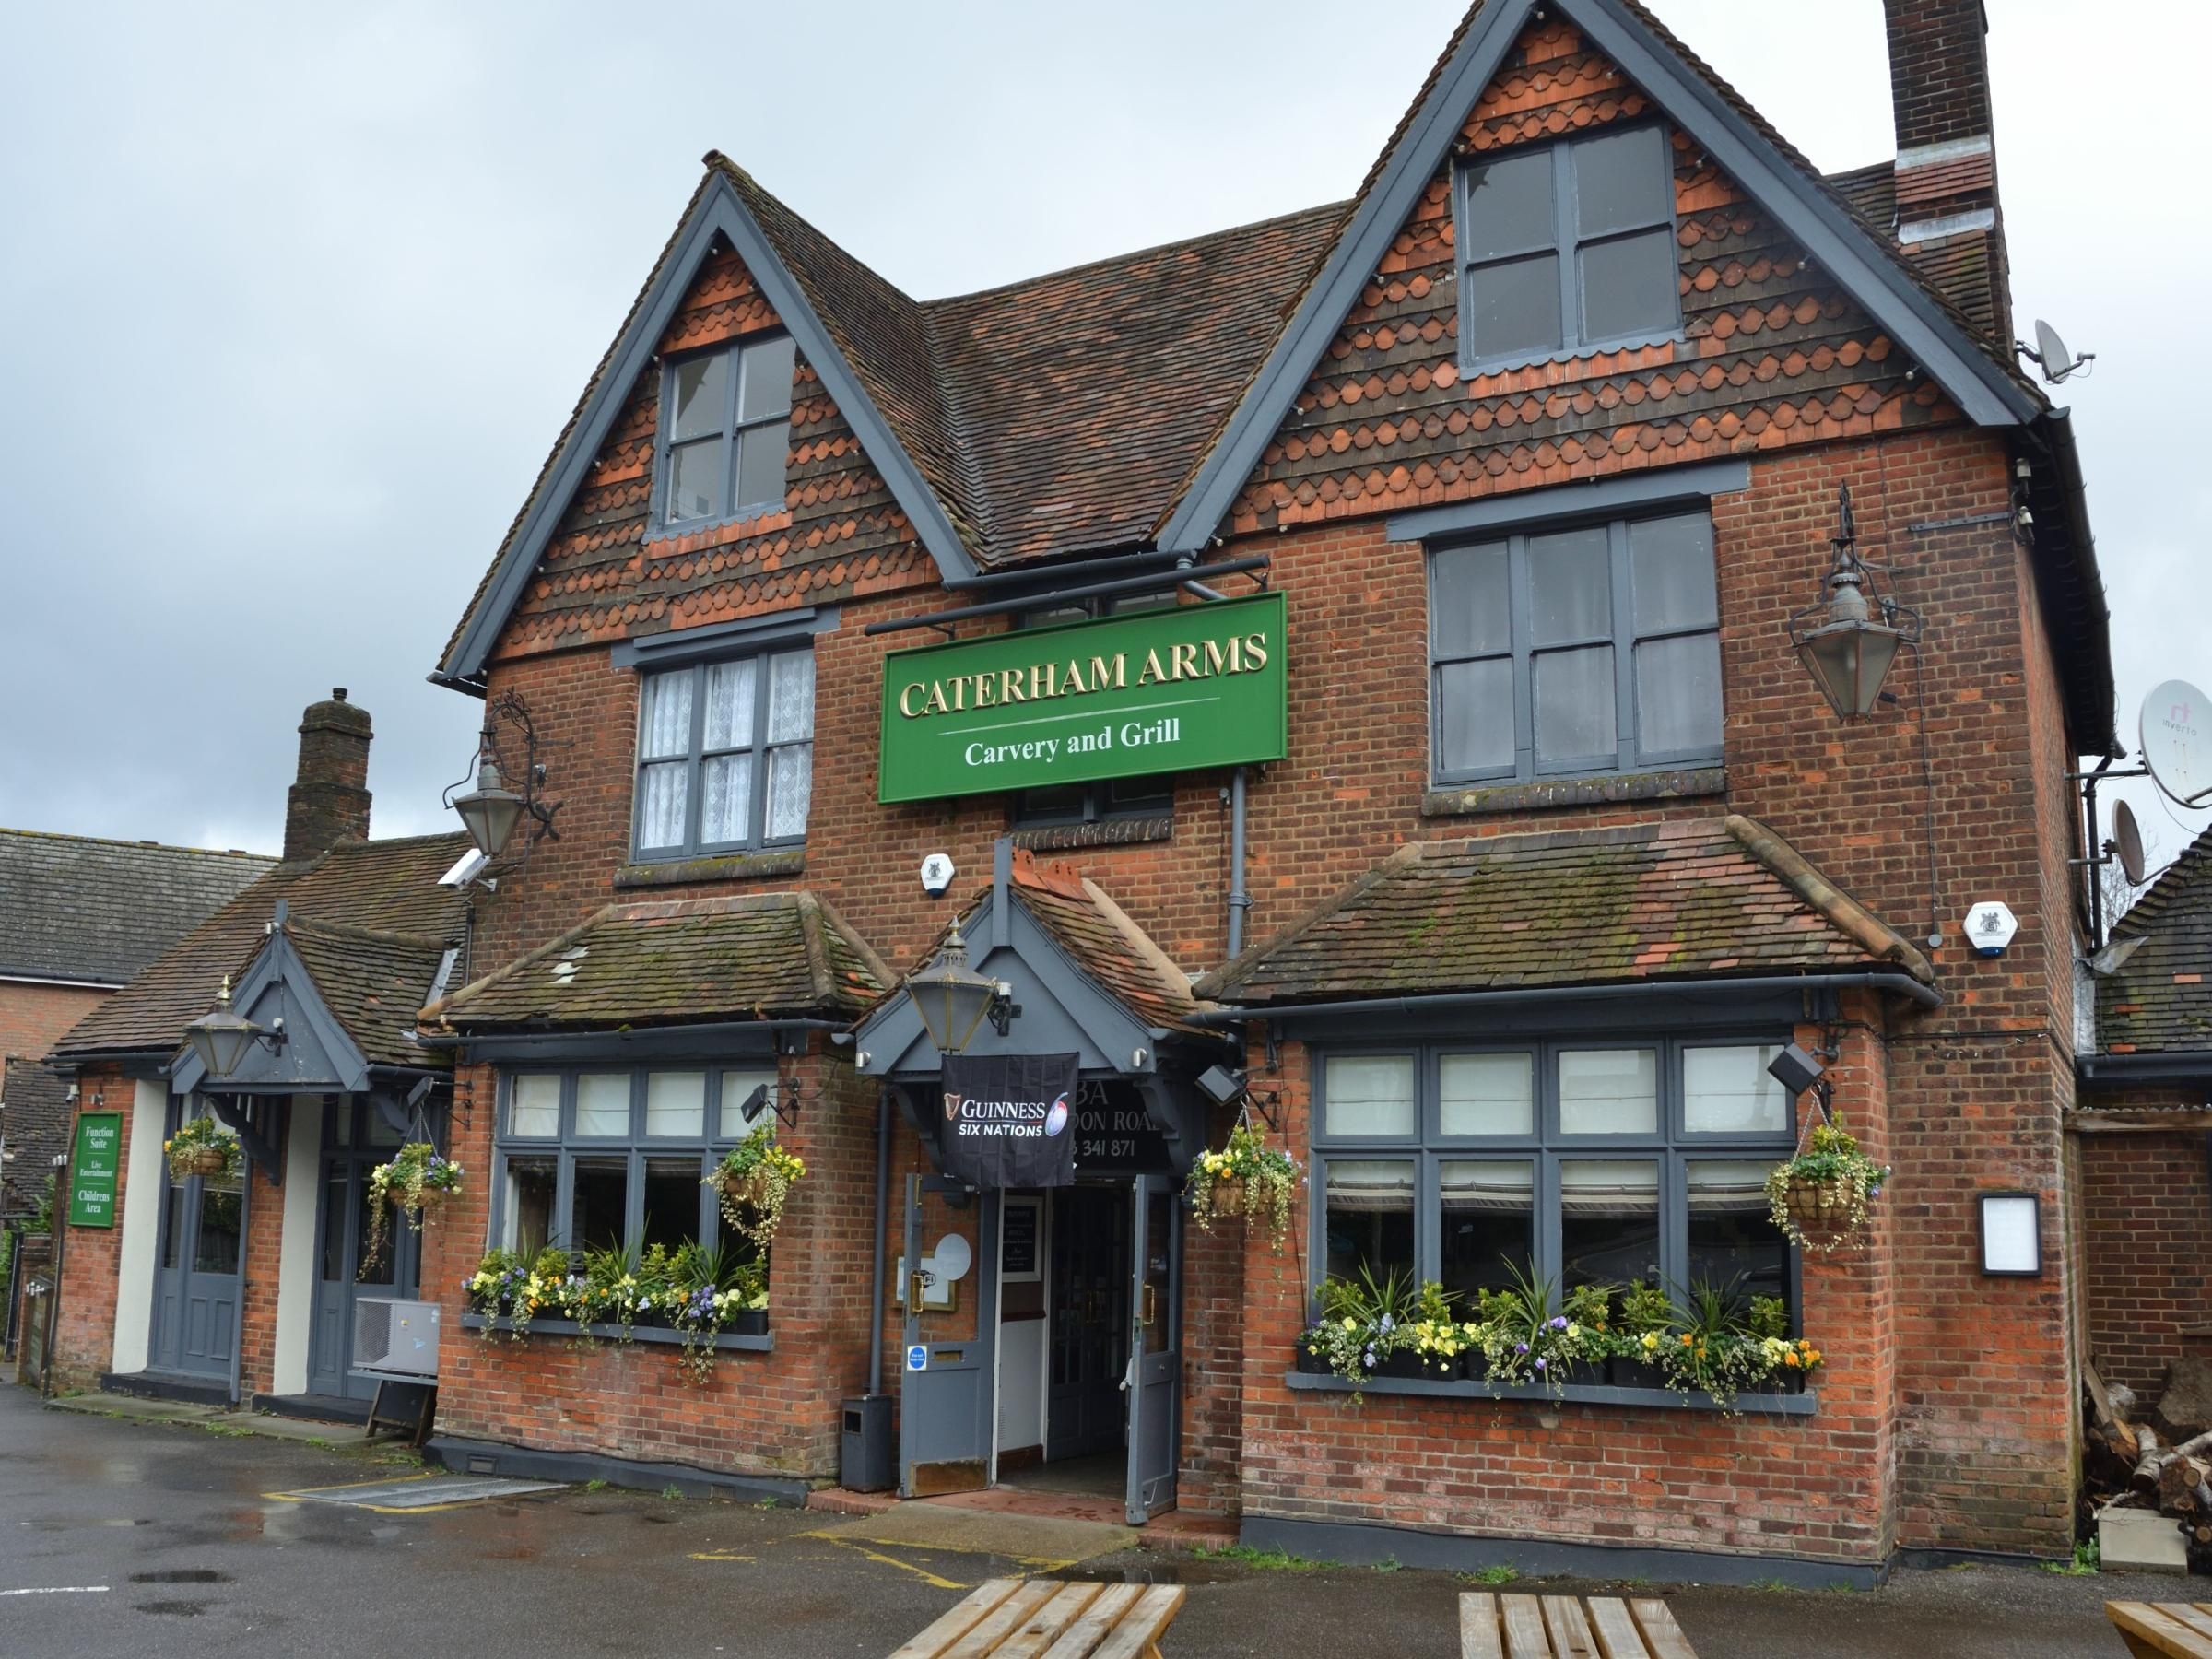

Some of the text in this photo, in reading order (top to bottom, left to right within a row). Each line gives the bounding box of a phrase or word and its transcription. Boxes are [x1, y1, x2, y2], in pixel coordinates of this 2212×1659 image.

[899, 632, 1268, 718] CATERHAM ARMS
[2162, 718, 2197, 736] inverto
[964, 717, 1181, 766] Carvery and Grill
[961, 1100, 1046, 1119] GUINNESS
[1113, 1112, 1160, 1132] ROA
[85, 1125, 114, 1138] Function
[959, 1124, 1043, 1137] SIX NATIONS
[90, 1137, 107, 1149] Suite
[1082, 1139, 1106, 1157] 341
[1110, 1139, 1135, 1157] 871
[90, 1160, 102, 1169] Live
[78, 1189, 110, 1202] Childrens
[85, 1202, 101, 1213] Area
